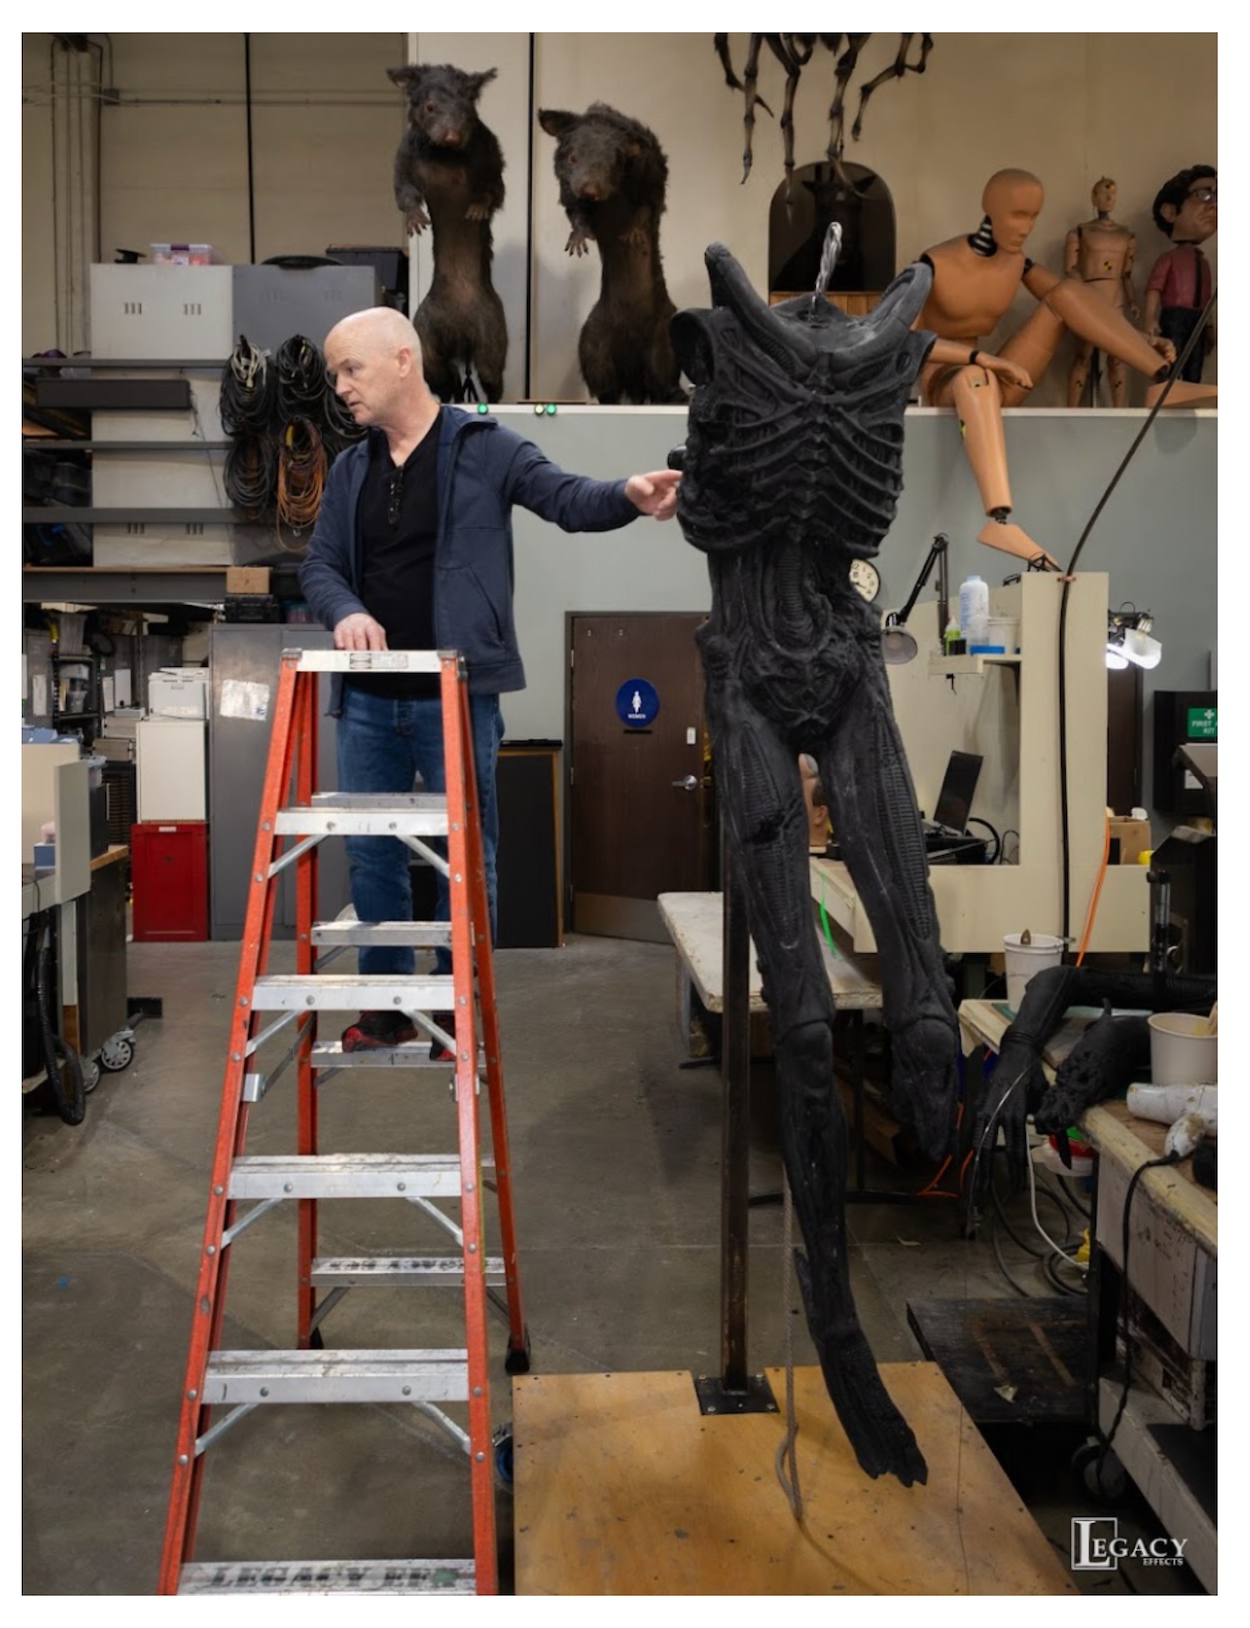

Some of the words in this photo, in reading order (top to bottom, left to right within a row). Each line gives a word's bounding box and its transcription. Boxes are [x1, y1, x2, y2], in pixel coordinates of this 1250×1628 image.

[1191, 720, 1212, 728] FIRST
[1203, 727, 1215, 735] KIT
[210, 1565, 372, 1588] LEGACY
